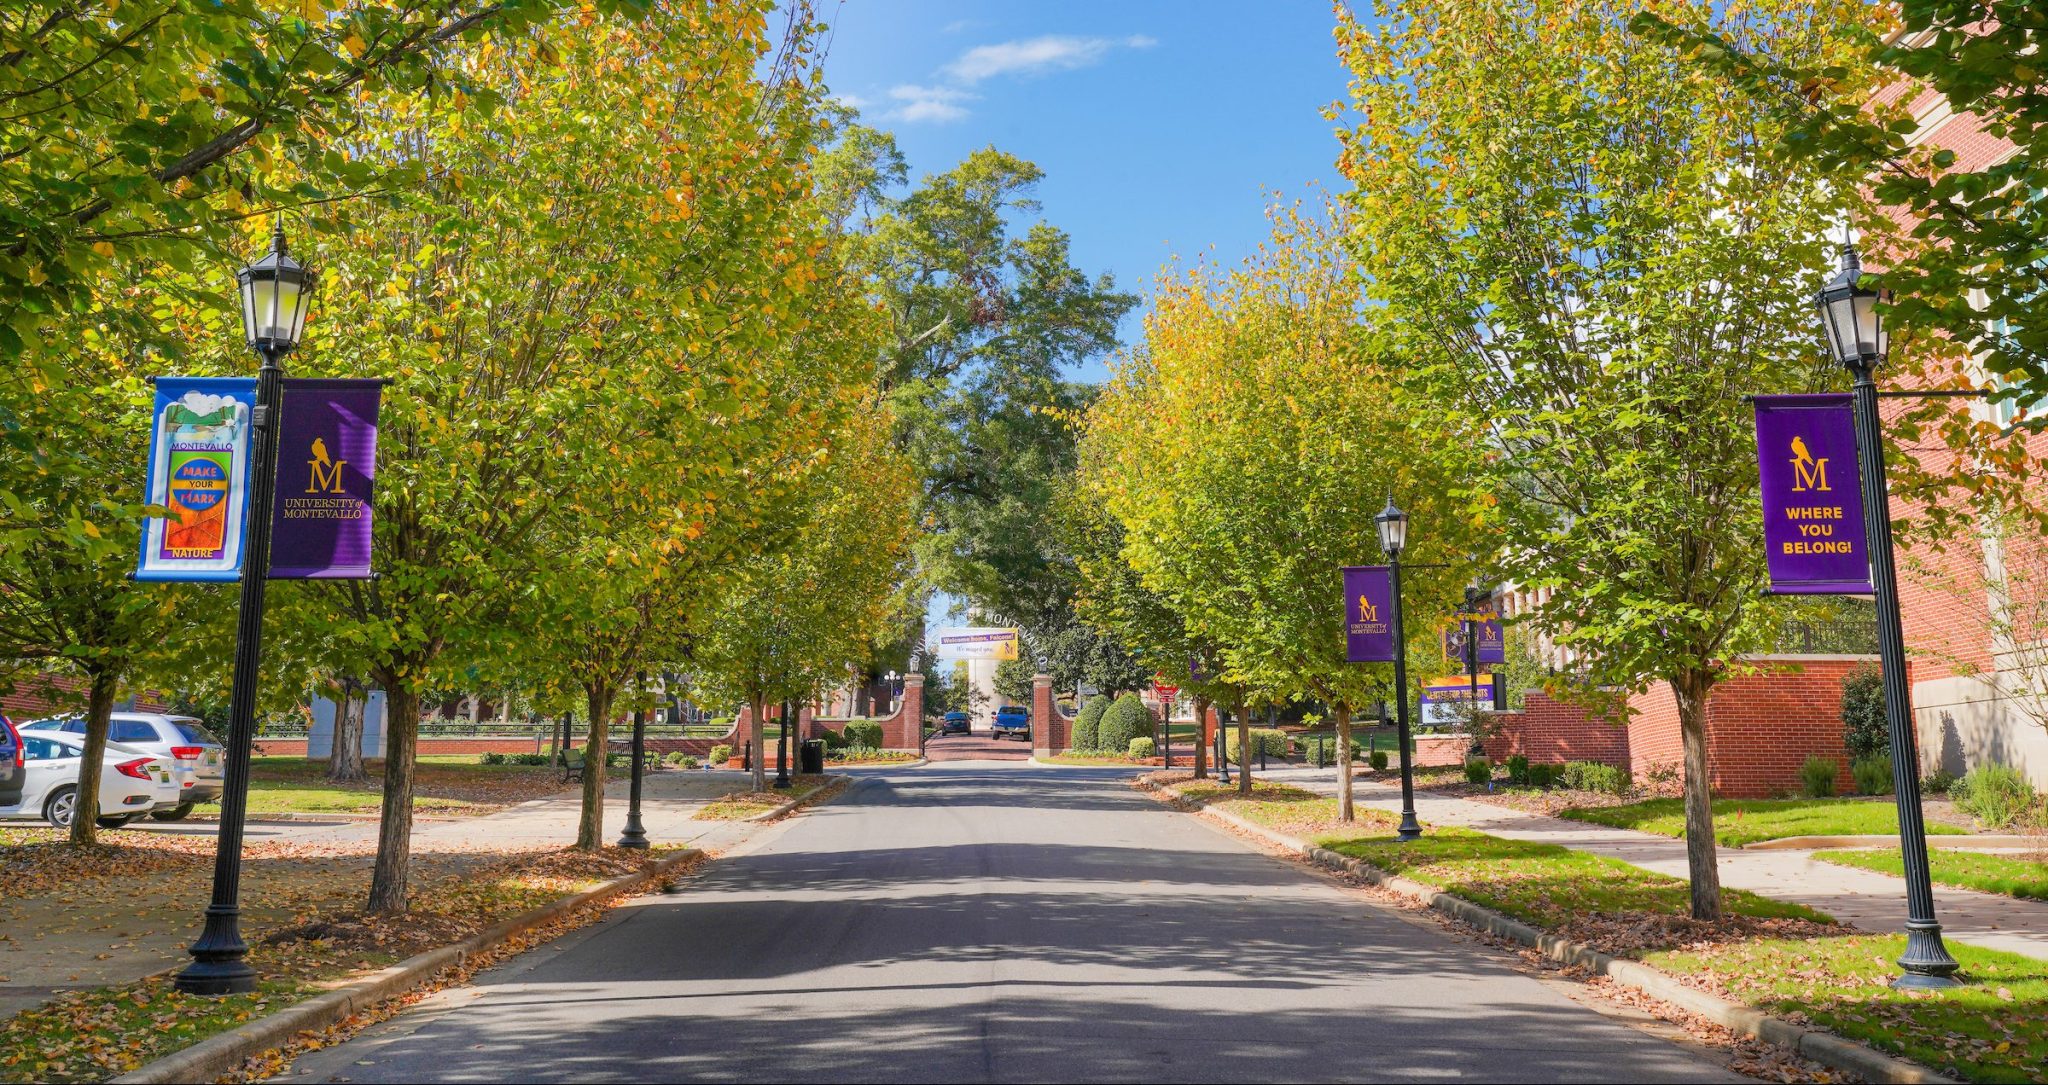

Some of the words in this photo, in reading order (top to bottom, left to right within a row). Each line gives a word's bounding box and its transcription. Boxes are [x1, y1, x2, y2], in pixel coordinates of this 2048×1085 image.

[171, 442, 233, 451] MONTEVALLO
[182, 467, 217, 477] MAKE
[305, 460, 347, 493] M
[1789, 458, 1831, 492] M
[189, 480, 213, 489] YOUR
[180, 493, 216, 504] MARK
[285, 499, 355, 508] UNIVERSITY
[283, 509, 362, 519] MONTEVALLO
[1786, 507, 1843, 520] WHERE
[1799, 524, 1833, 537] YOU
[172, 548, 213, 558] NATURE
[1783, 541, 1852, 554] BELONG!
[1359, 605, 1378, 621] M
